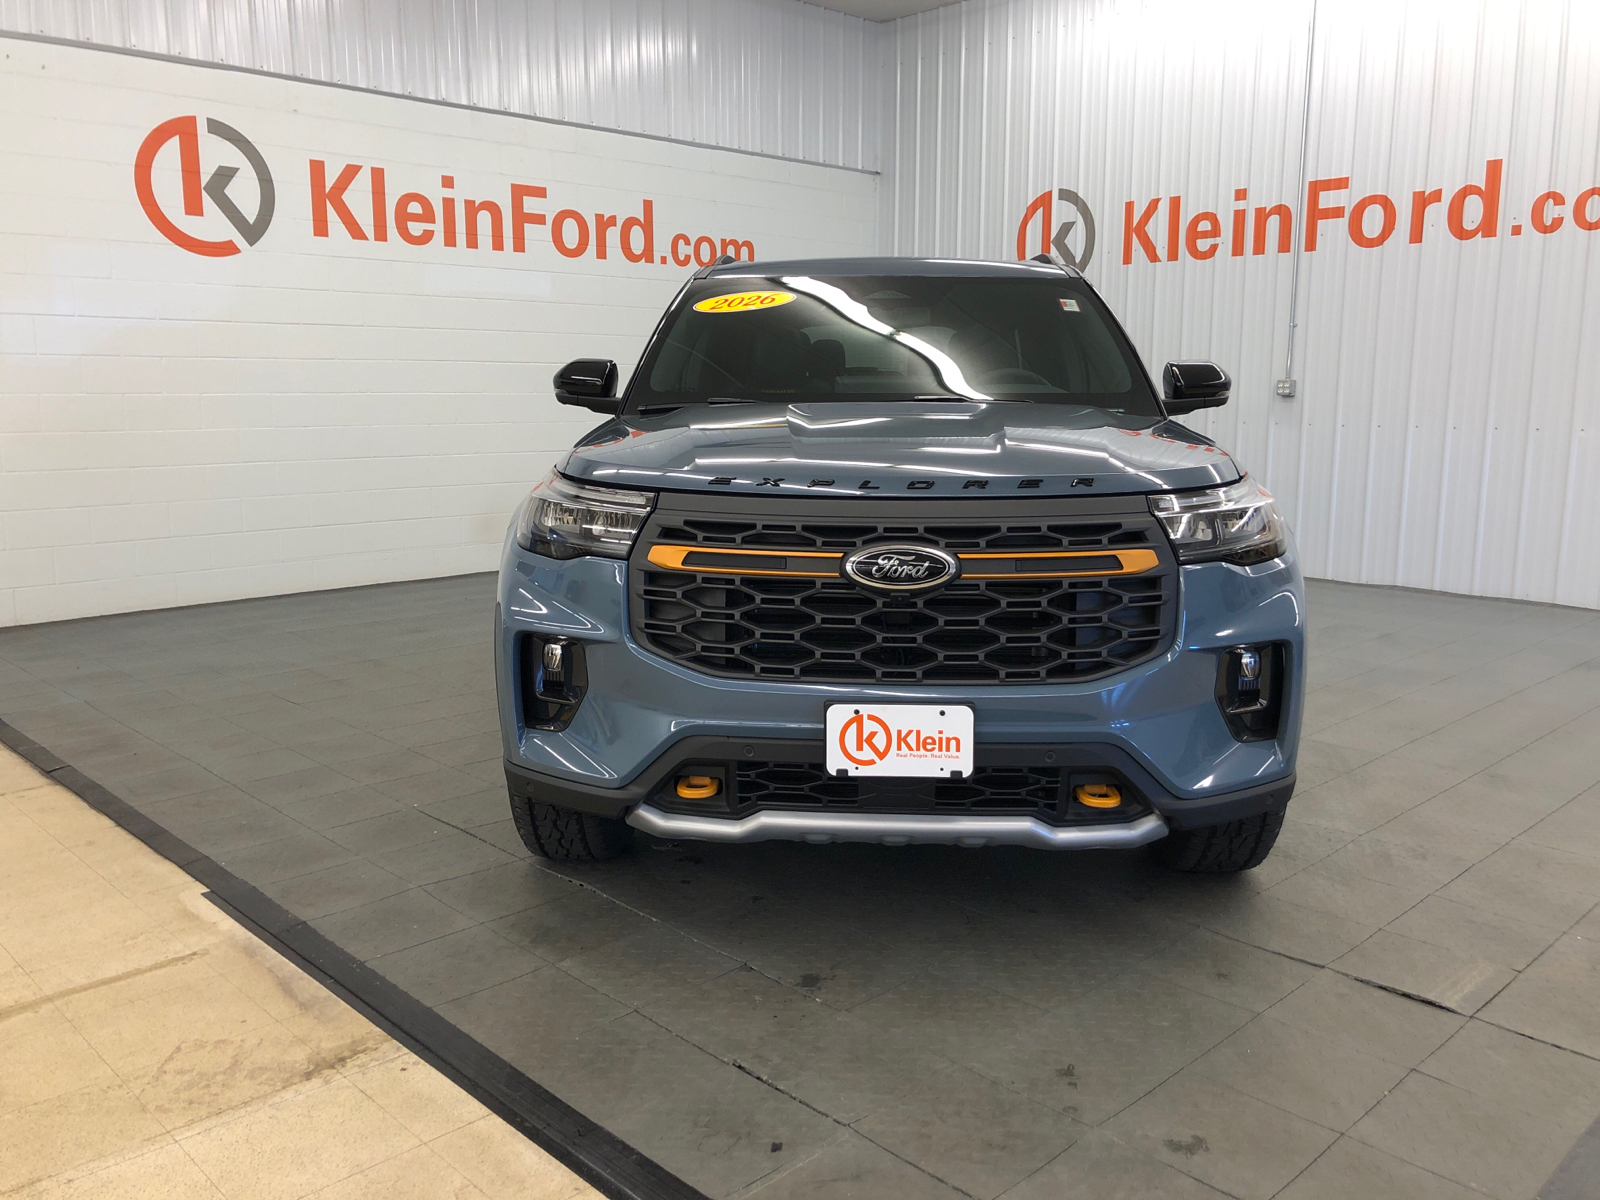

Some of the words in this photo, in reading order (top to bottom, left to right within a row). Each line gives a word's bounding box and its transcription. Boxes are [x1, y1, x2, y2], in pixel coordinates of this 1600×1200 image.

[309, 159, 755, 268] KleinFord.com
[709, 293, 780, 310] 2026
[708, 476, 1095, 490] EXPLORER
[871, 554, 931, 578] Ford
[896, 729, 961, 752] Klein
